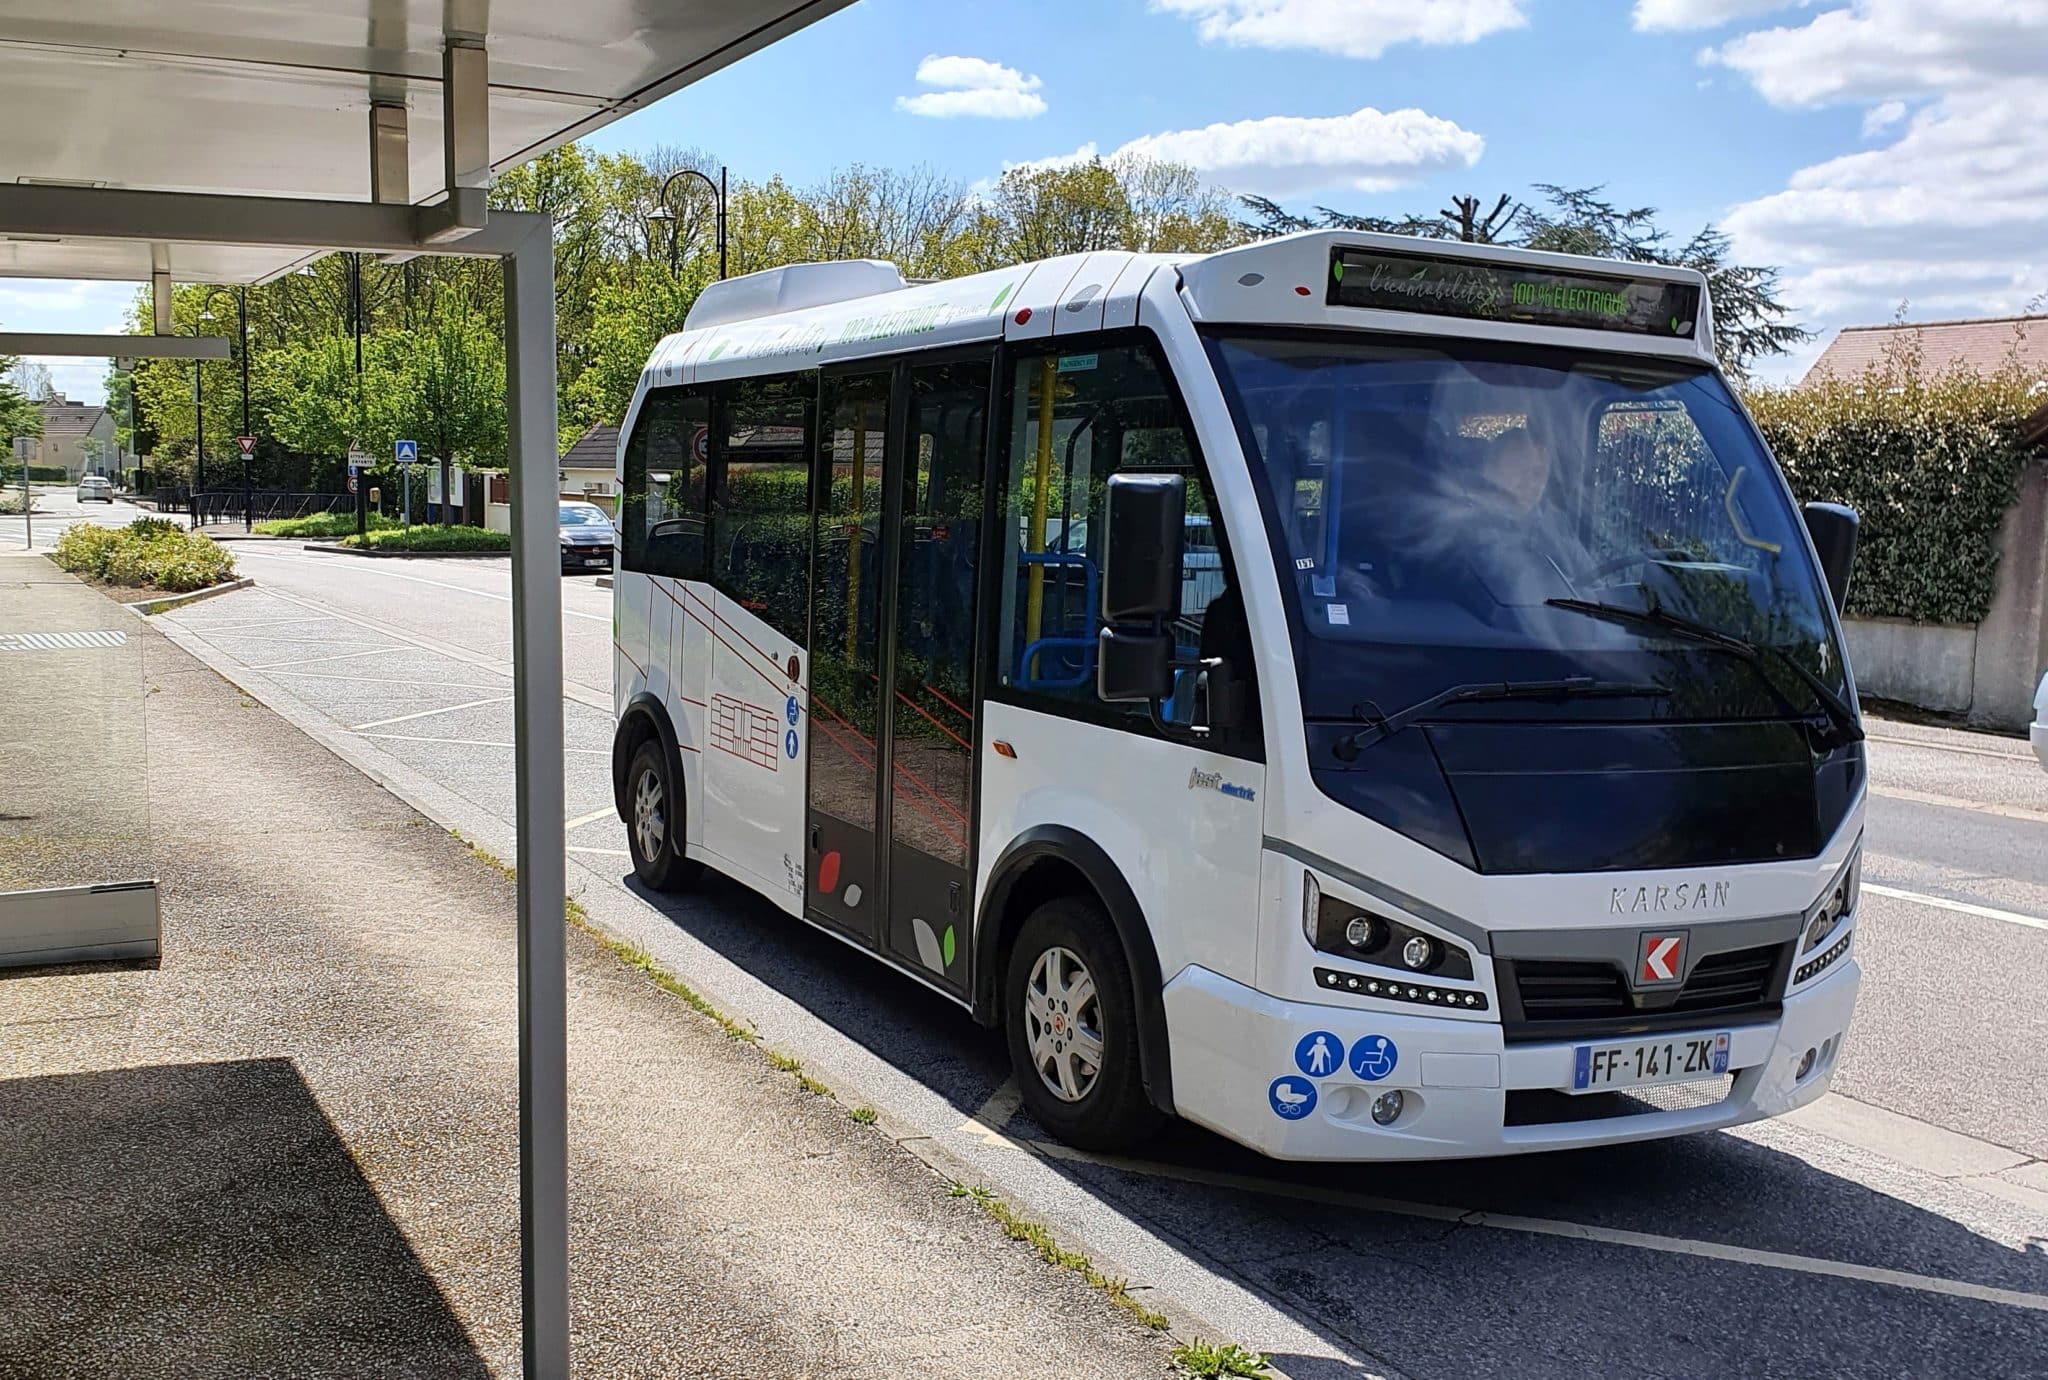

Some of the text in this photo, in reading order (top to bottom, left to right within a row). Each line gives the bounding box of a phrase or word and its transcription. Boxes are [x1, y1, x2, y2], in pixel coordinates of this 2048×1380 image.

[1512, 282, 1535, 306] 100
[1609, 881, 1730, 914] KARSAN
[1592, 1040, 1713, 1083] FF-141-ZK
[1714, 1053, 1727, 1068] 78
